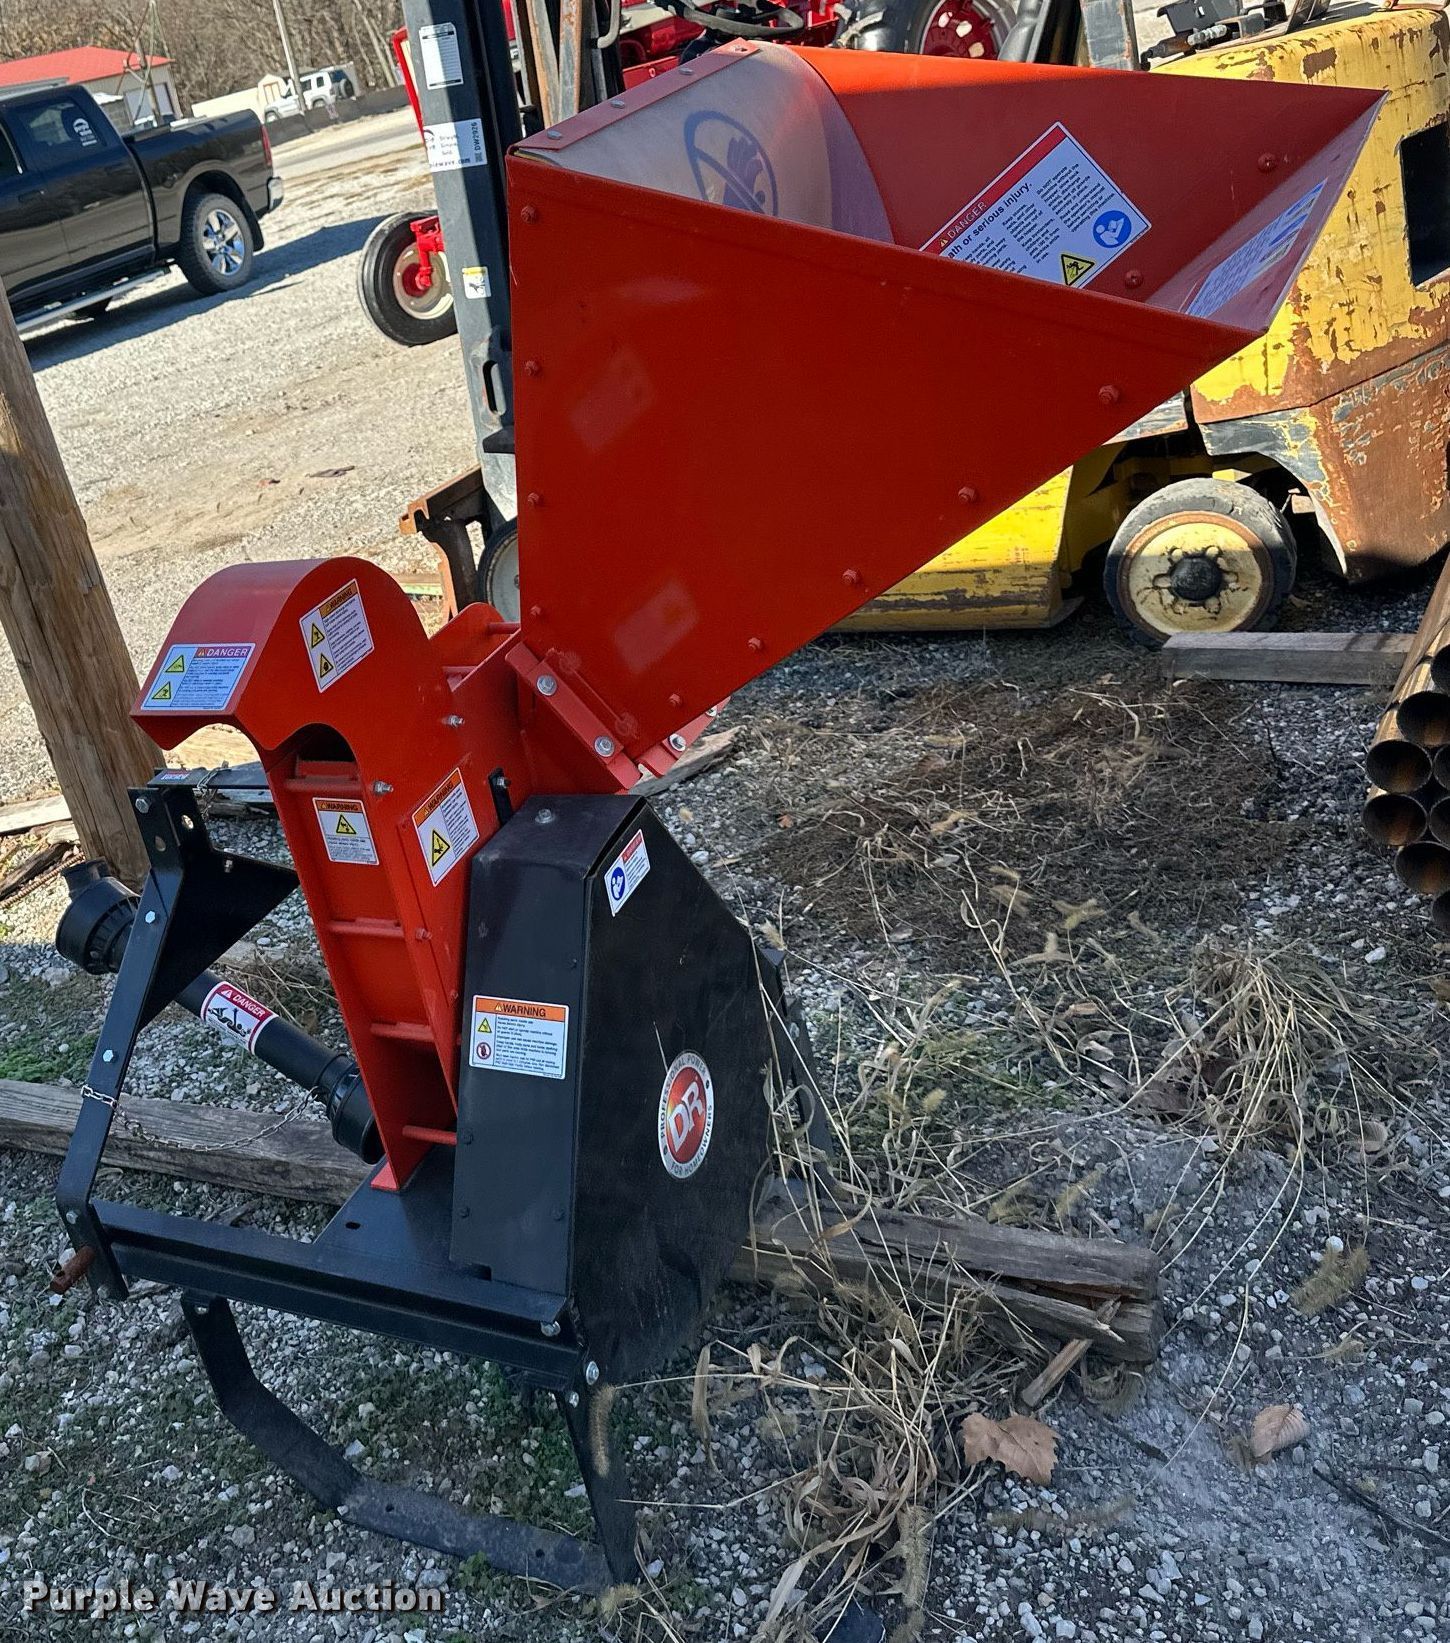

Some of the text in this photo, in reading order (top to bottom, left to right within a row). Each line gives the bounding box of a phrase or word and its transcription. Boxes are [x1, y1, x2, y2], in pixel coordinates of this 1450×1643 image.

[947, 201, 987, 239] DANGER
[948, 183, 1032, 259] ath or serious injury.
[206, 647, 249, 658] DANGER
[232, 995, 266, 1018] DANGER
[502, 1003, 546, 1017] WARNING
[660, 1054, 706, 1139] PROFESSIONAL POWER
[668, 1081, 704, 1153] DR
[670, 1104, 712, 1176] FOR HOMEOWNERS
